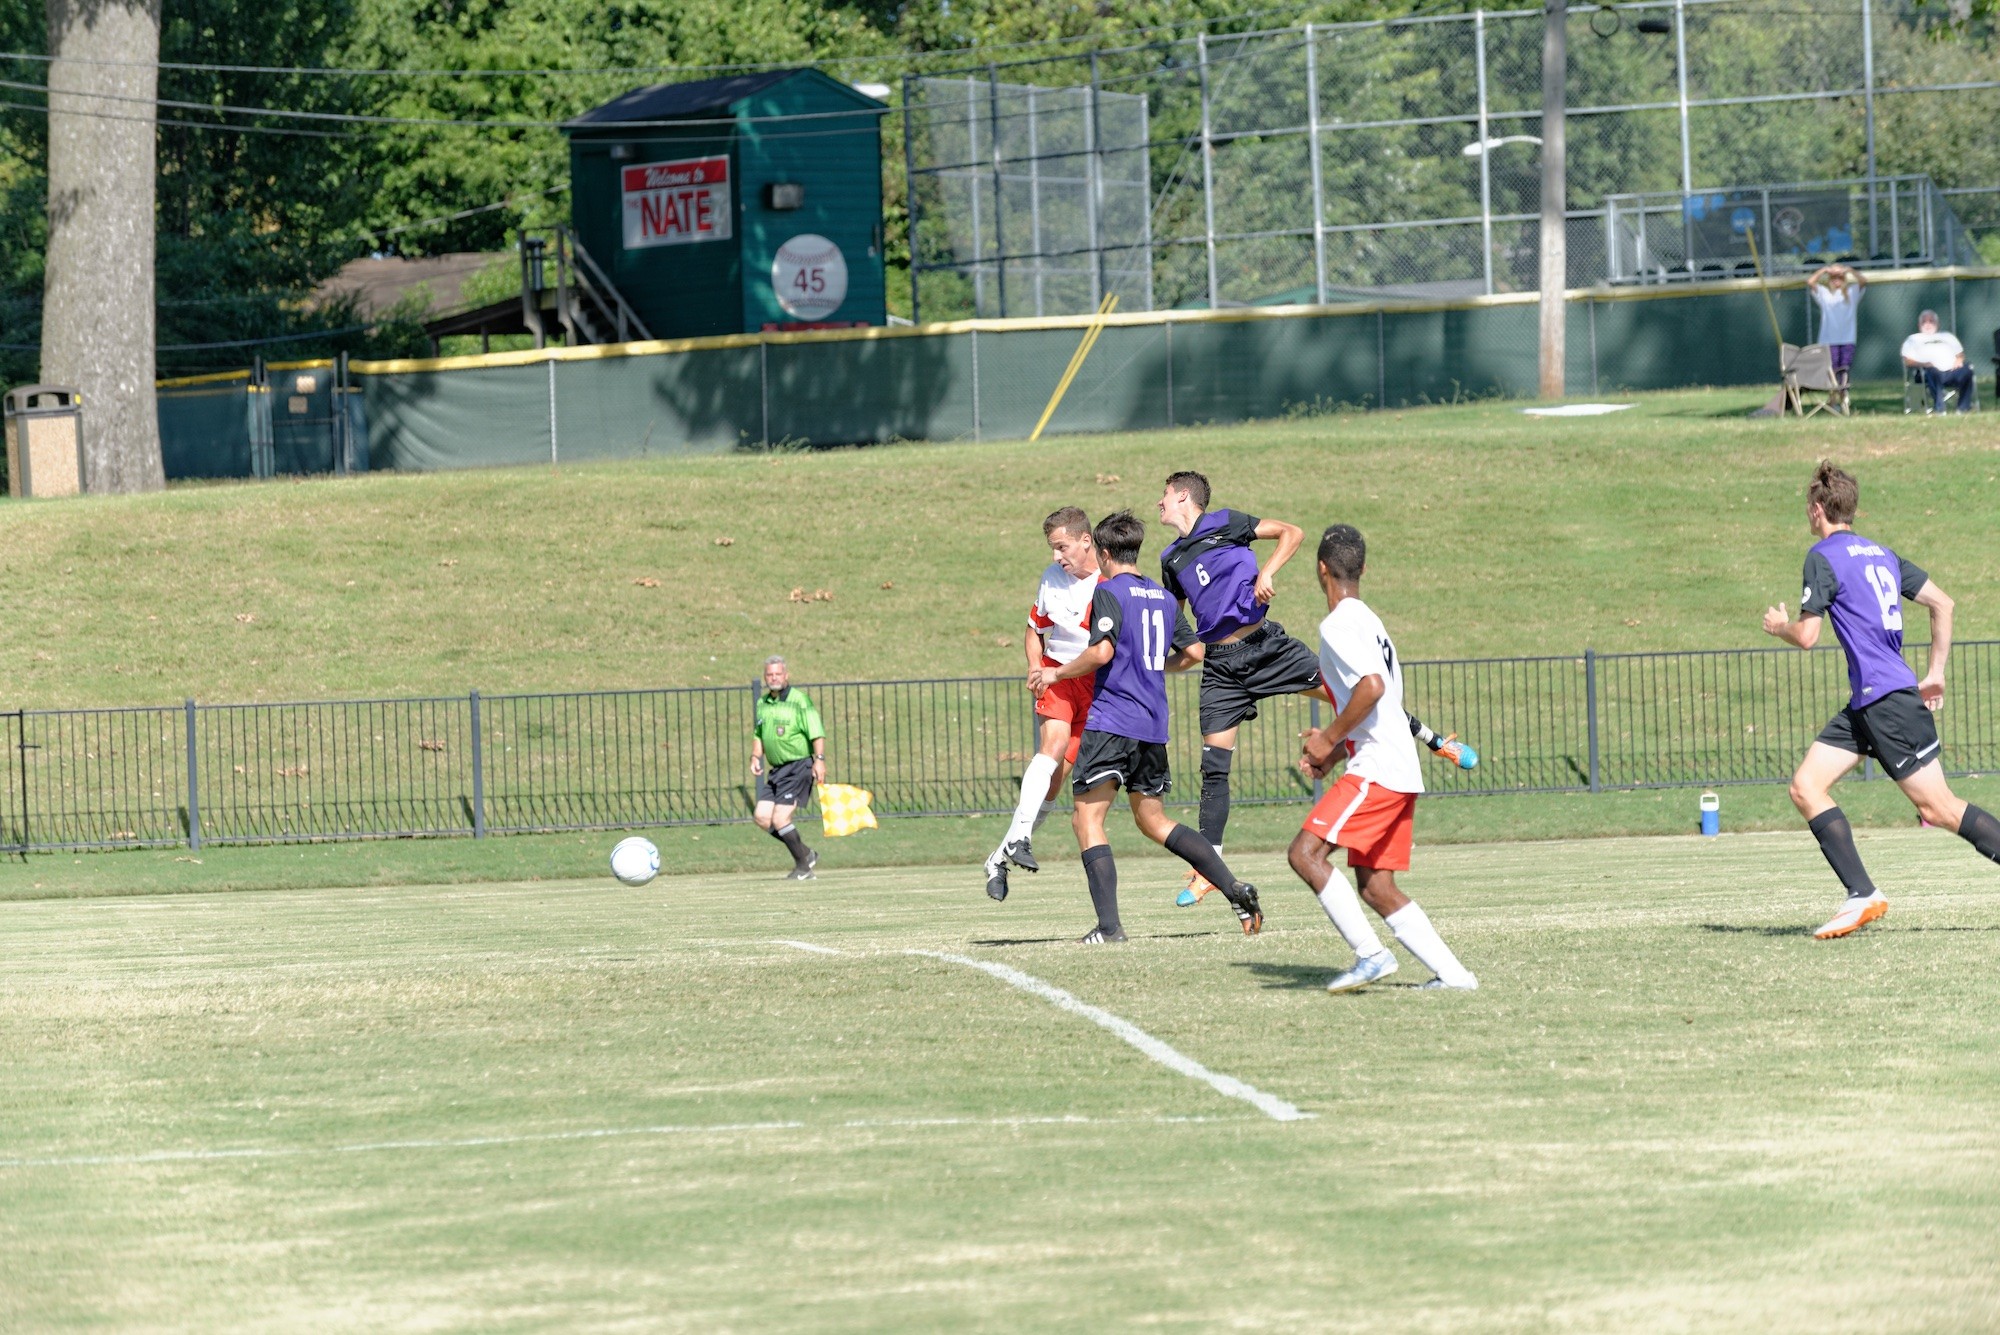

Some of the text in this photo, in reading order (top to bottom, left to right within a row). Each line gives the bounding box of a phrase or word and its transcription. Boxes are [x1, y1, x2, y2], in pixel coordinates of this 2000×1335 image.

[645, 166, 705, 189] Welcome to
[641, 189, 713, 237] NATE
[793, 268, 826, 293] 45
[1196, 563, 1210, 587] 6
[1865, 564, 1902, 631] 12
[1141, 608, 1165, 671] 11
